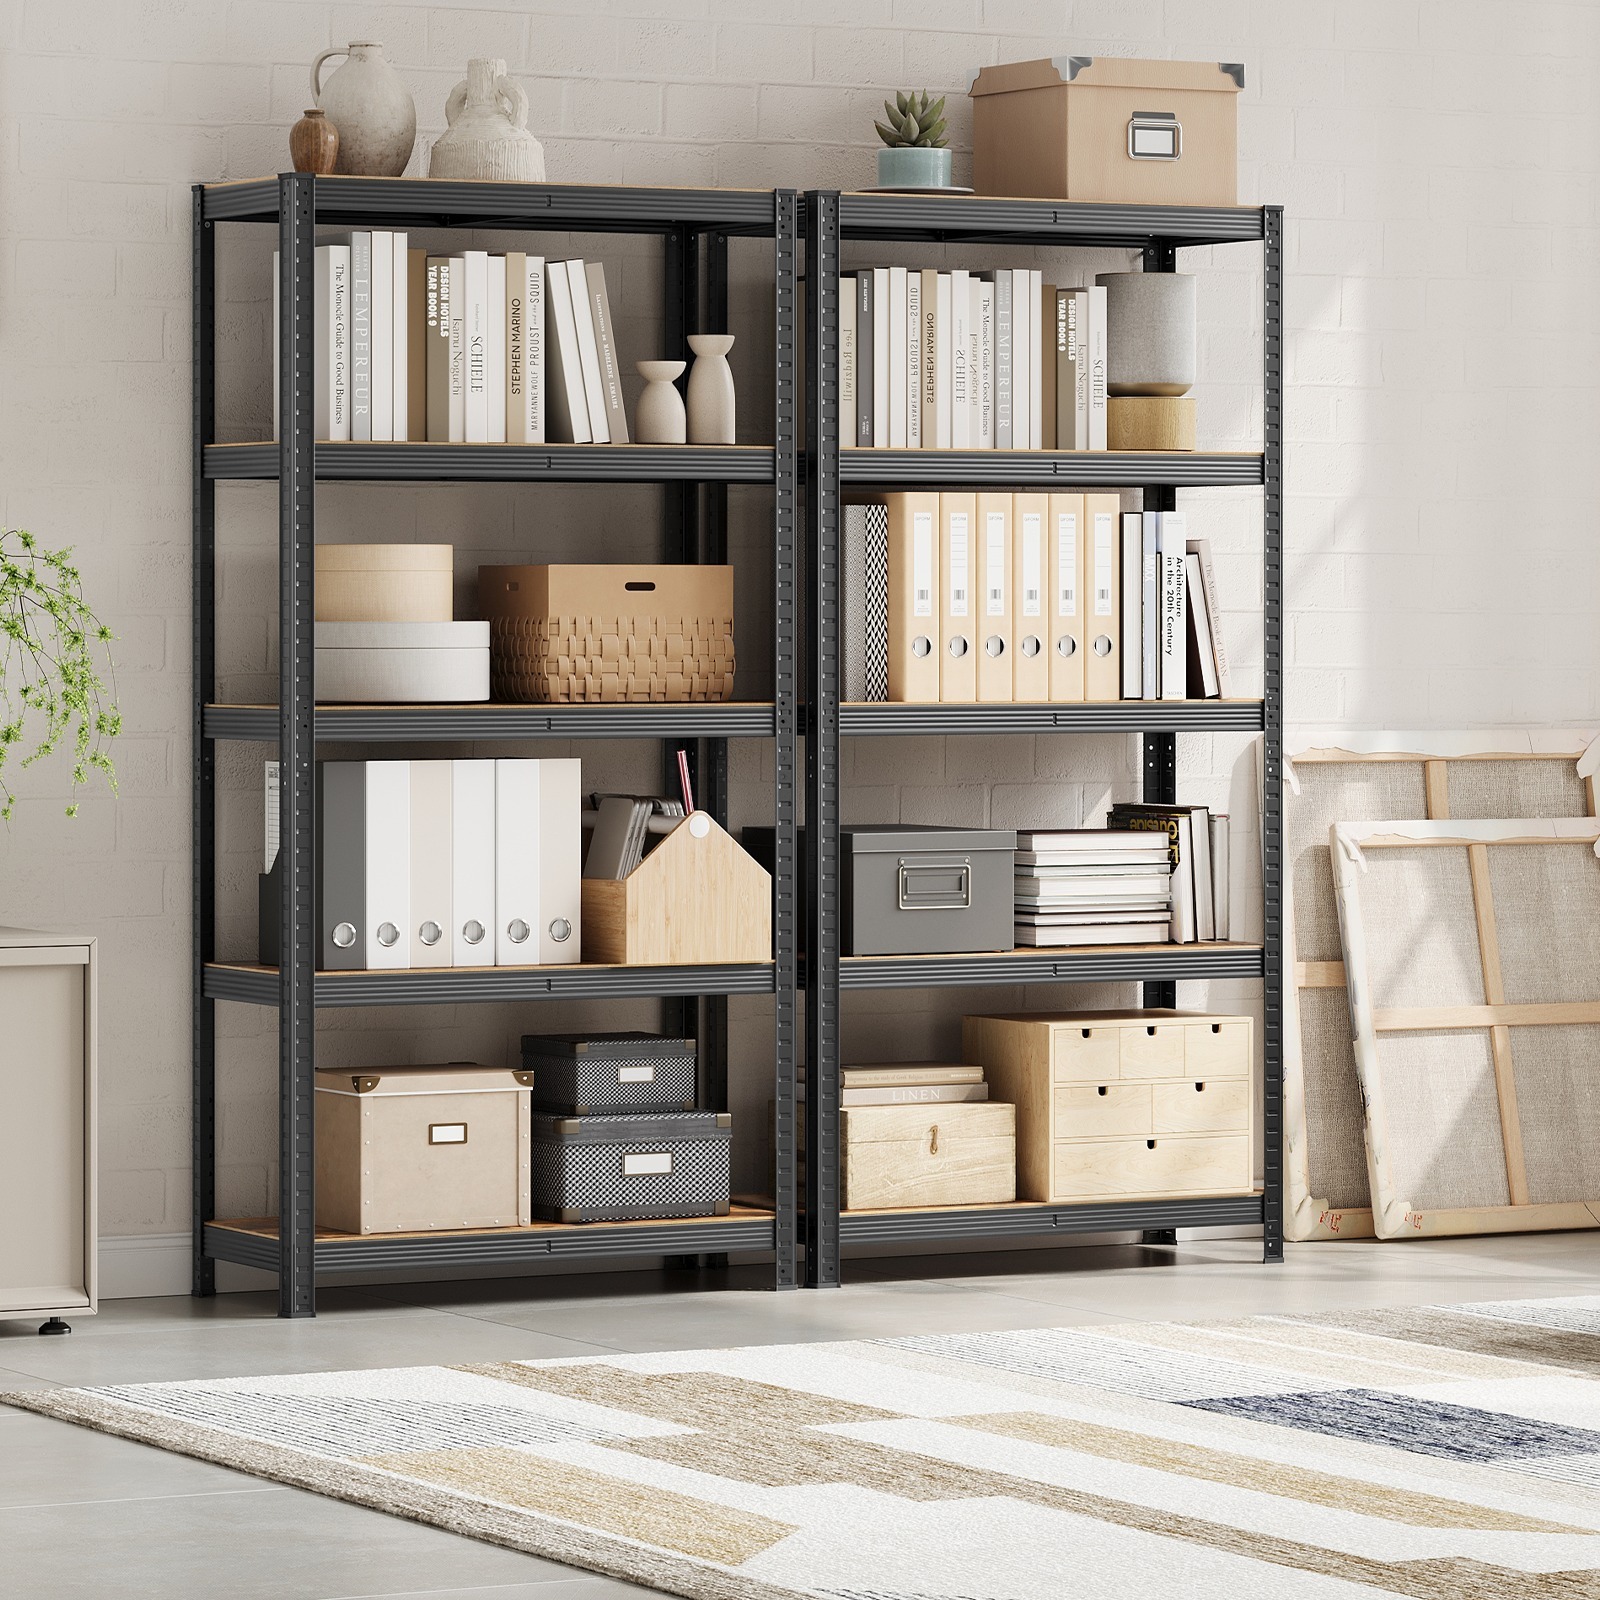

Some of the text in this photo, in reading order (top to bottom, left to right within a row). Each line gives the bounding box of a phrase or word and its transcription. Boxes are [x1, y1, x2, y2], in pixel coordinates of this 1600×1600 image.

[428, 265, 438, 327] YEAR BOOK 9
[440, 265, 449, 338] DESIGN HOTELS
[530, 272, 540, 303] SQUID
[982, 297, 990, 313] The
[1058, 299, 1066, 320] YEAR
[335, 263, 344, 425] The Monocle Guide to Good Business
[355, 279, 369, 416] LEMPEREUR
[511, 298, 521, 394] STEPHEN MARINO
[530, 326, 540, 366] PROUST
[982, 314, 990, 347] Monocle
[1058, 321, 1066, 343] BOOK
[450, 318, 463, 396] Isamu Noguchi
[471, 336, 483, 393] SCHIELE
[982, 348, 990, 370] Guide
[999, 310, 1010, 428] LEMPEREUR
[531, 371, 539, 391] WOLF
[982, 381, 990, 405] Good
[1077, 344, 1087, 411] Isamu Noguchi
[1093, 359, 1104, 409] SCHIELE
[531, 391, 539, 431] MARYANNE
[982, 405, 990, 436] Business
[1167, 556, 1174, 566] in
[1167, 589, 1175, 613] 20th
[1176, 556, 1184, 618] Architecture
[1165, 616, 1175, 656] Century
[1207, 580, 1217, 614] Monocle
[1212, 615, 1221, 636] Book
[1217, 648, 1227, 677] JAPAN
[892, 1089, 941, 1101] LINEN
